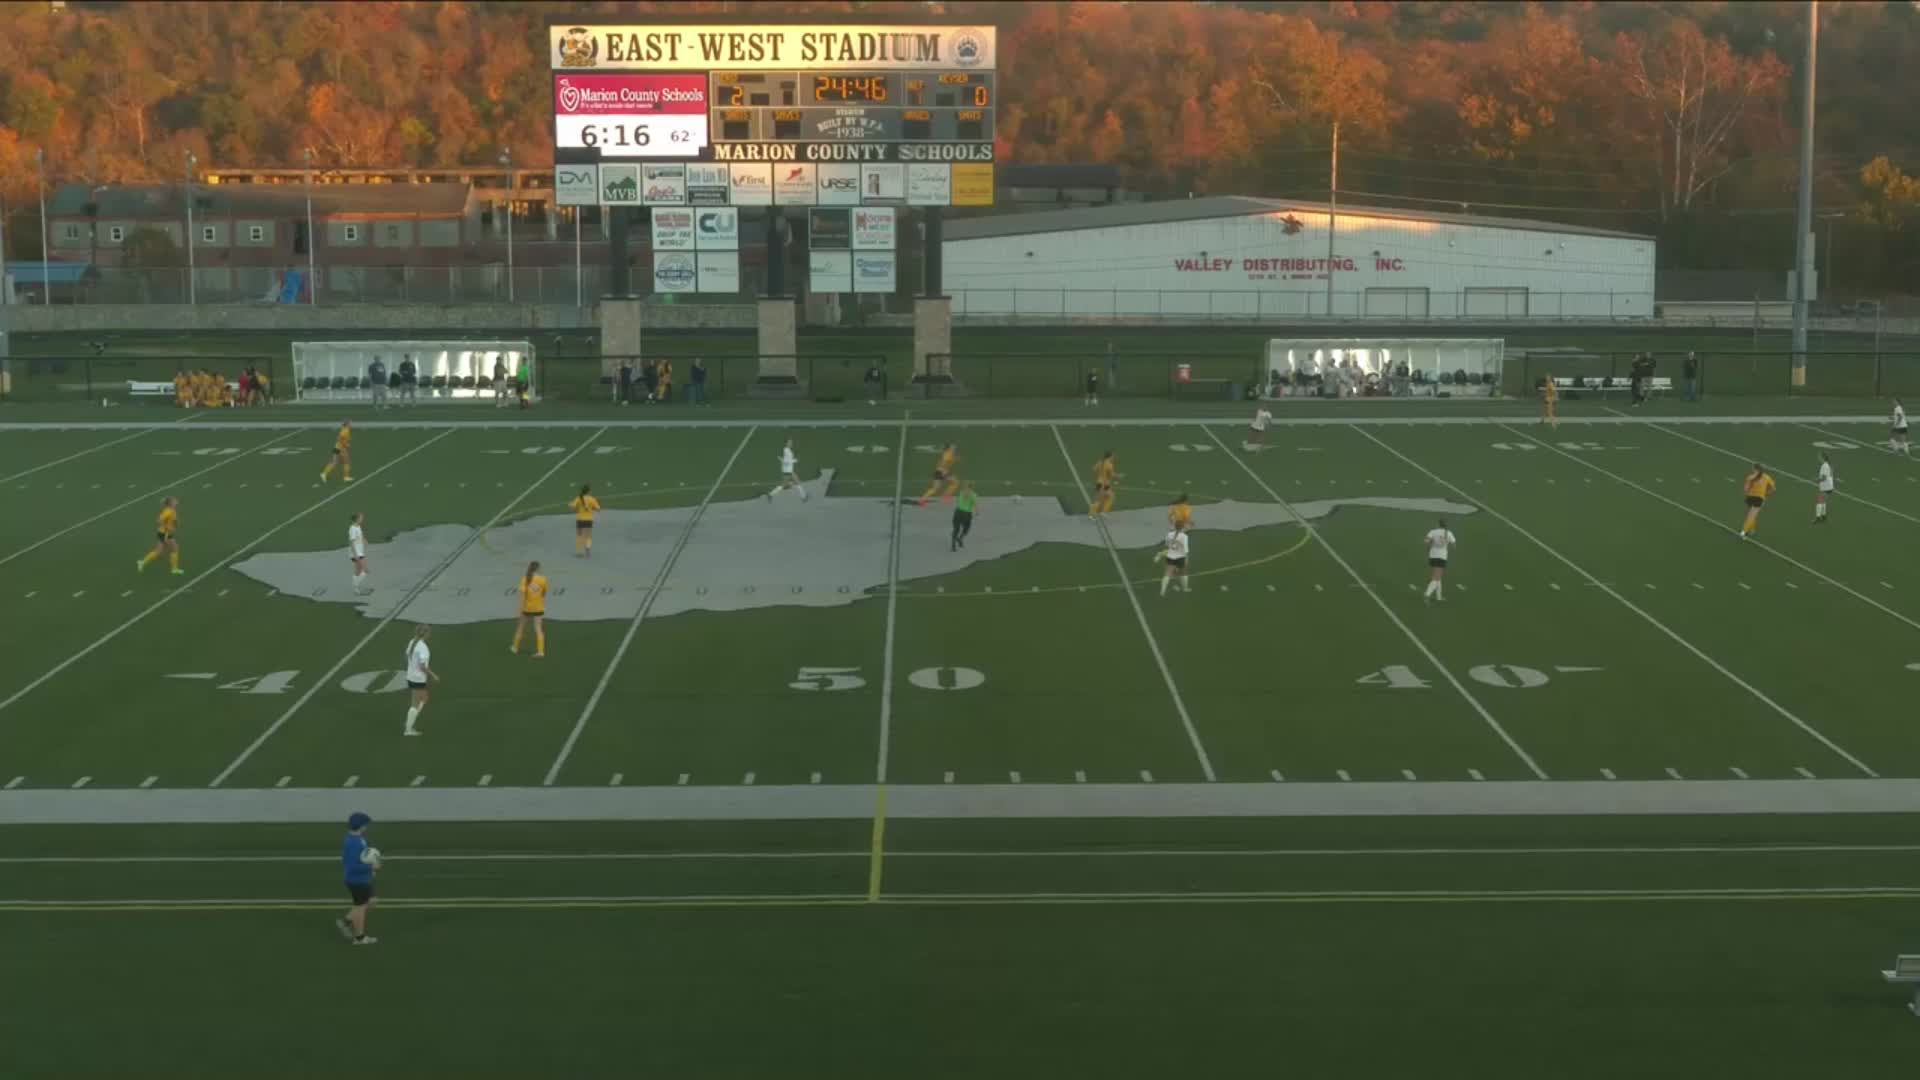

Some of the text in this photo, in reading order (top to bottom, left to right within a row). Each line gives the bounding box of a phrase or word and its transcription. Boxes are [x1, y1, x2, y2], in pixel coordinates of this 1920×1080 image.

[801, 33, 941, 61] STADIUM
[580, 87, 704, 103] Marion County Schools
[731, 86, 743, 106] 2
[815, 76, 886, 100] 24:46
[975, 86, 987, 106] 0
[581, 124, 651, 146] 6:16
[714, 144, 992, 160] MARION COUNTY SCHOOLS
[604, 188, 637, 201] MVB
[1175, 258, 1406, 272] VALLEY DISTRIBUTNG, INC.
